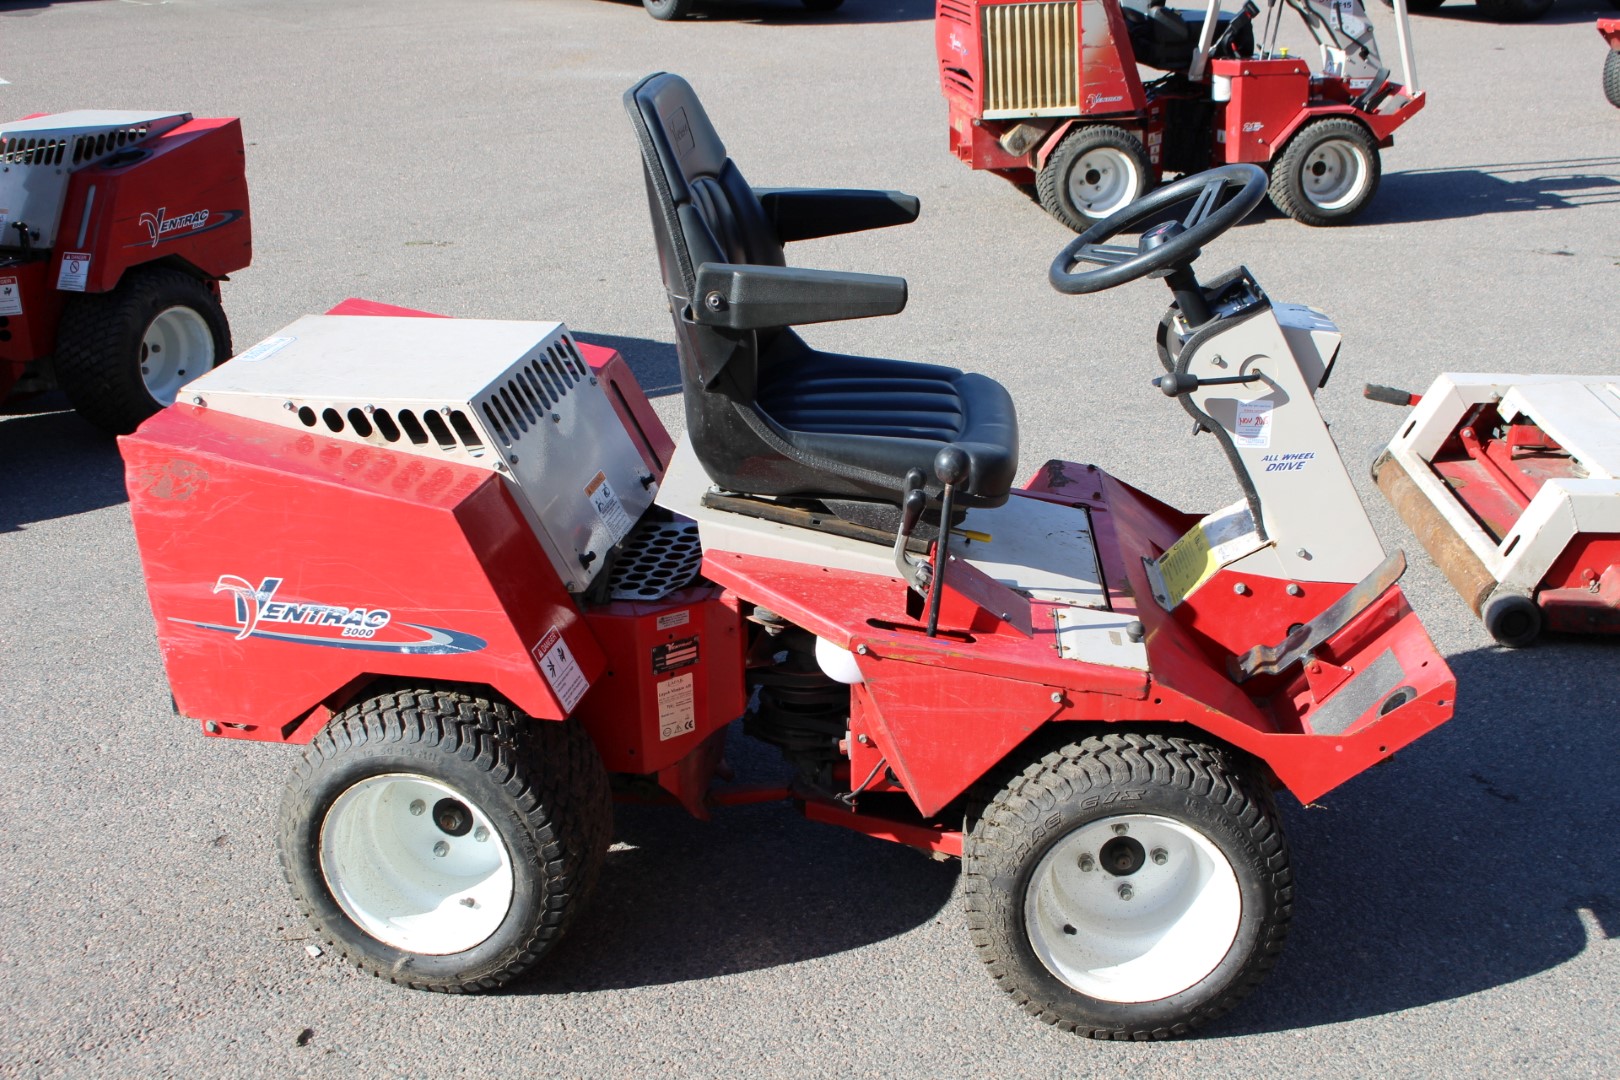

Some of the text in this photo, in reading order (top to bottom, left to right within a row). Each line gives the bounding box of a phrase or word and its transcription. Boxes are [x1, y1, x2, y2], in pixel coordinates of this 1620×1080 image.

[139, 207, 209, 247] VENTRAC
[1261, 452, 1315, 462] ALL WHEEL
[1265, 461, 1306, 472] DRIVE
[213, 574, 391, 640] VENTRAC
[342, 626, 376, 639] 3000
[541, 632, 558, 653] DANGER
